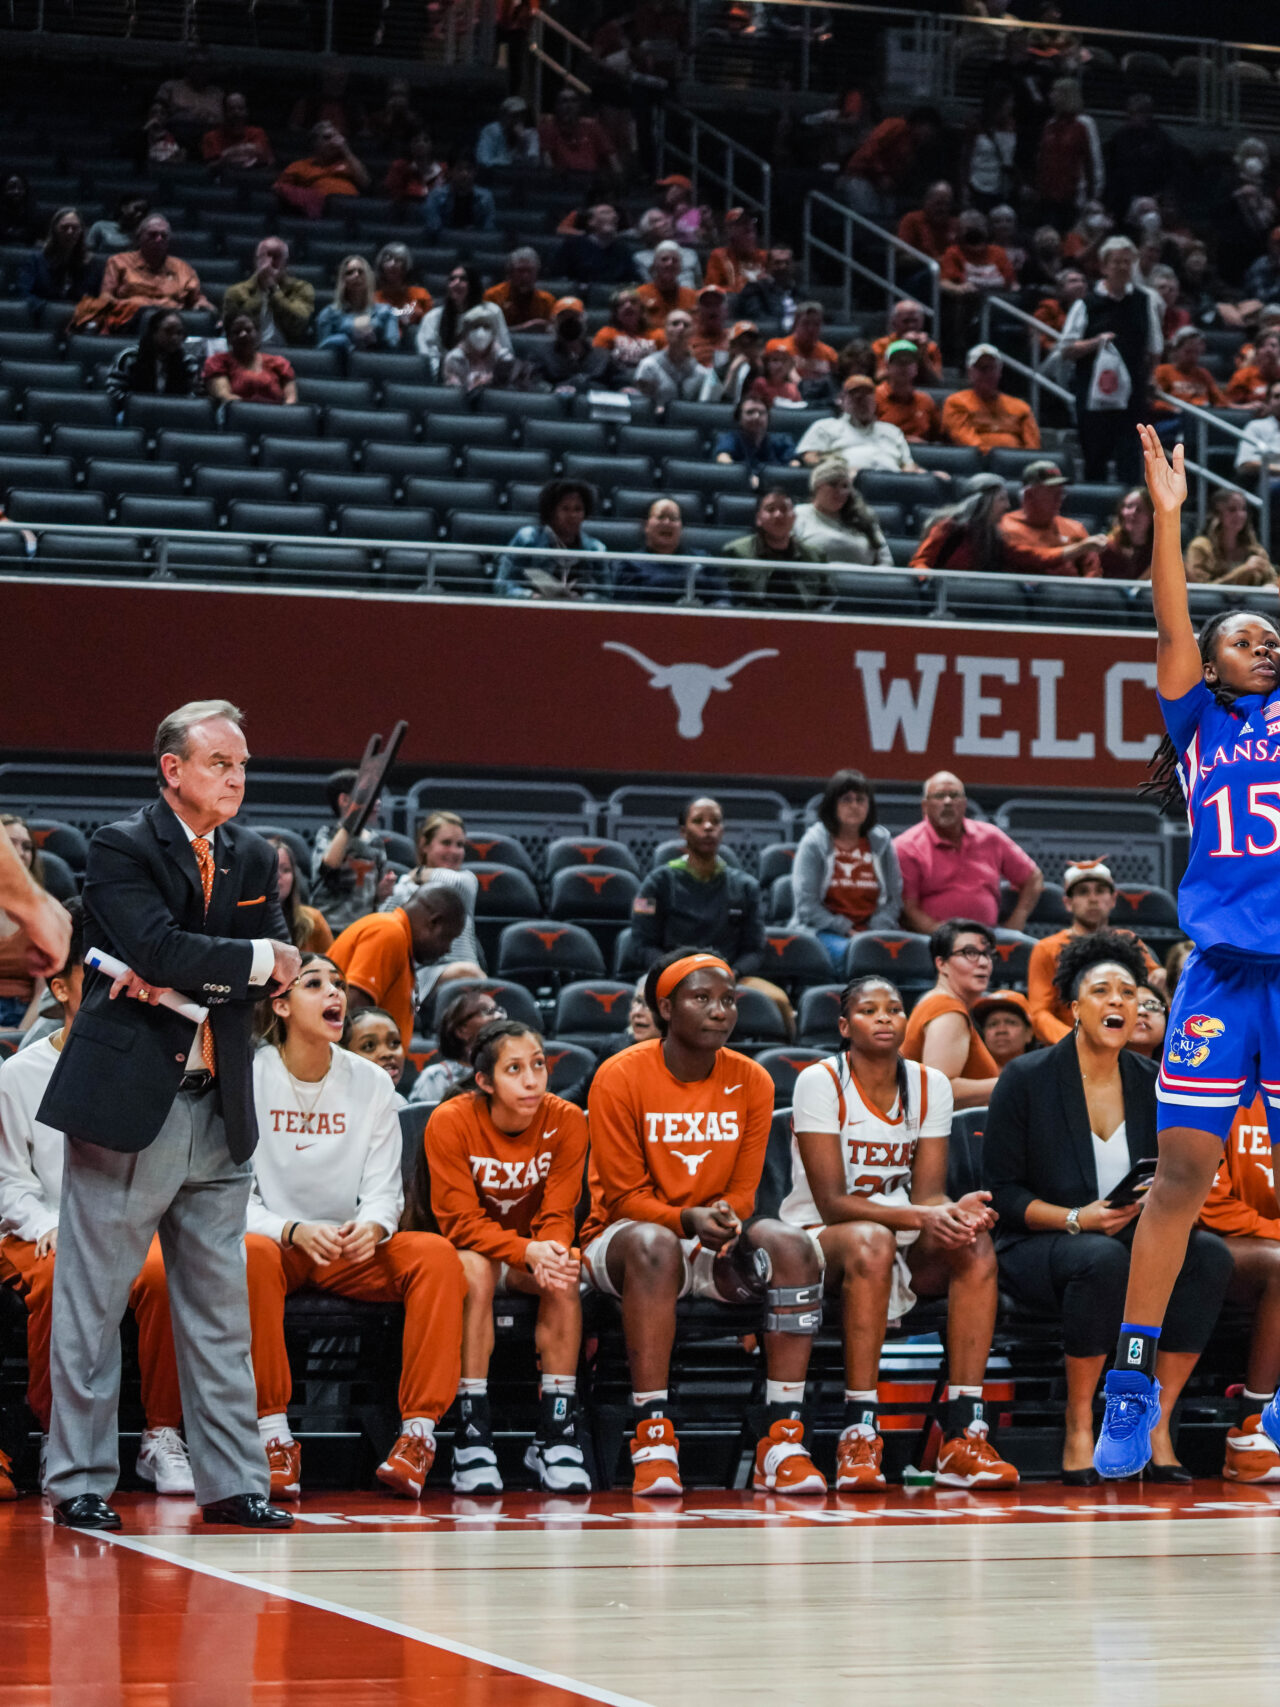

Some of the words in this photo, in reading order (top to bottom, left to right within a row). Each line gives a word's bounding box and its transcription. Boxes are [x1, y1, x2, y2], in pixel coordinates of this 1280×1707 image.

[1180, 1039, 1195, 1051] KU
[270, 1109, 346, 1135] TEXAS
[645, 1110, 740, 1143] TEXAS
[469, 1151, 552, 1190] TEXAS
